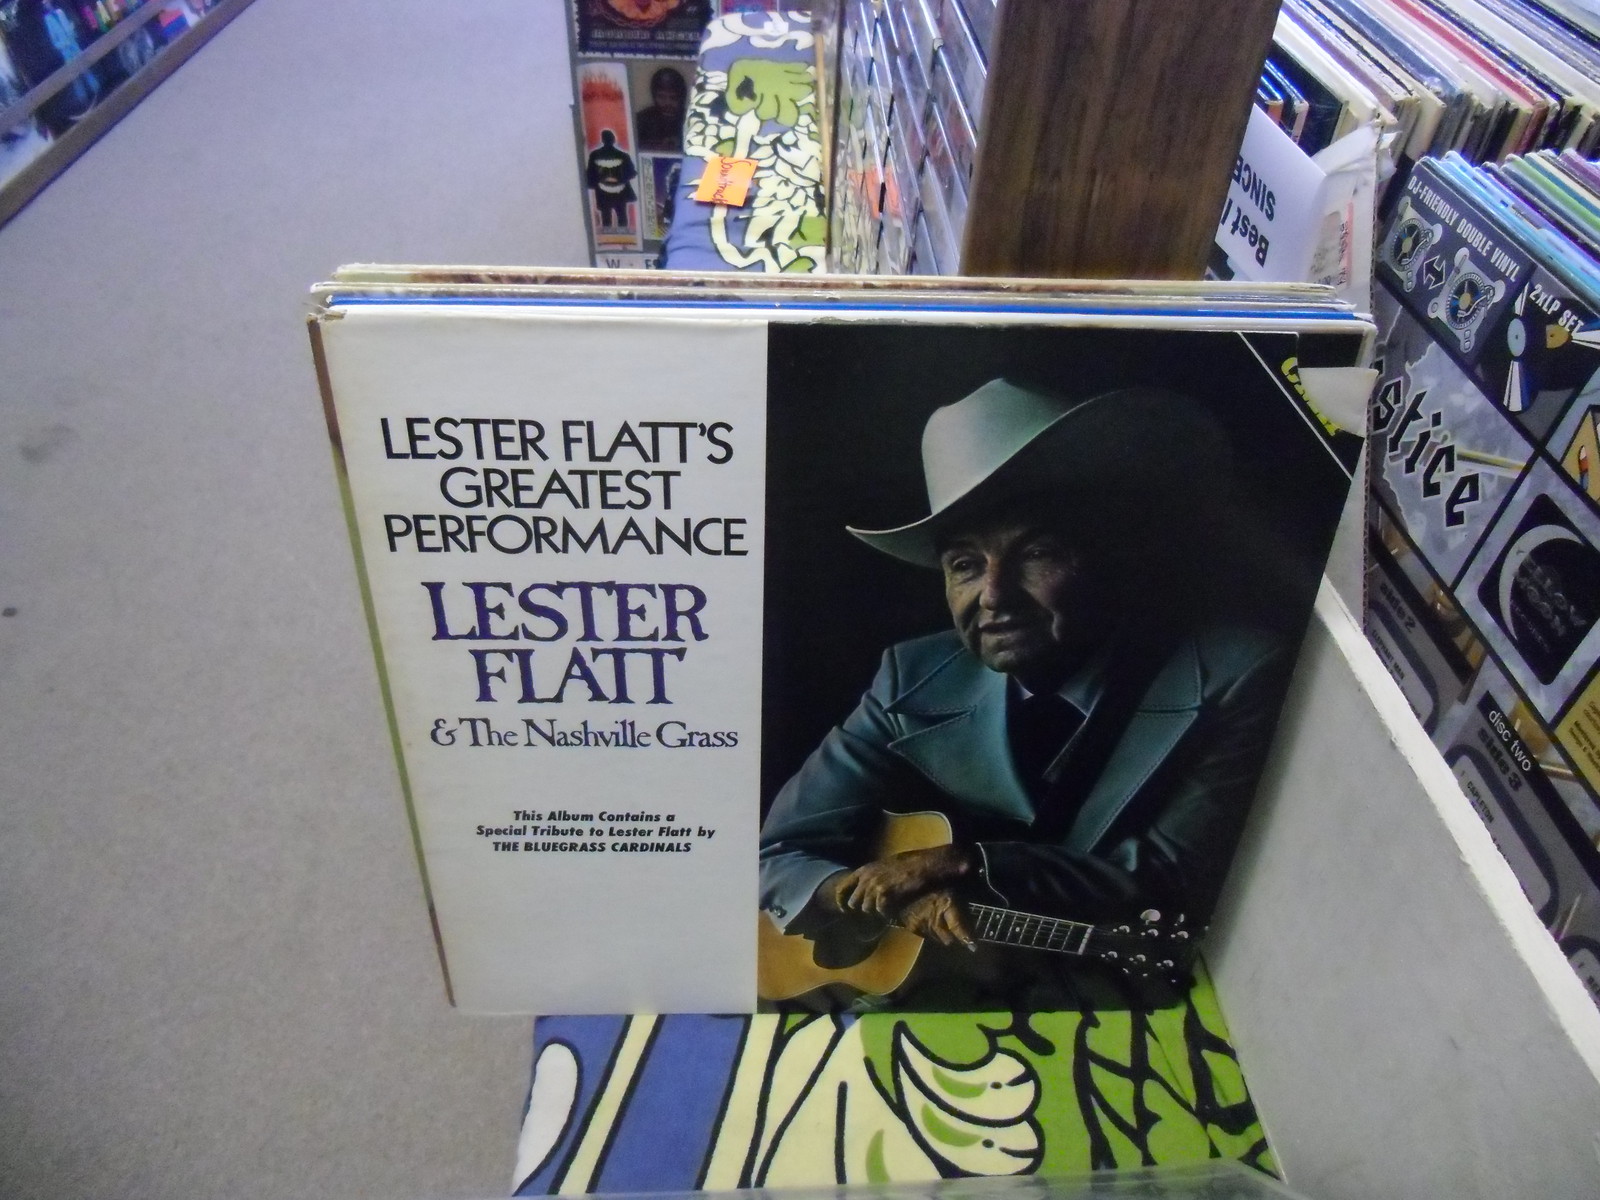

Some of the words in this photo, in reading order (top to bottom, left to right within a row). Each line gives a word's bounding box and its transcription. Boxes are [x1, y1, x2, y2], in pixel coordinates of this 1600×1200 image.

[1233, 156, 1277, 222] SINCE
[1229, 223, 1269, 267] Best
[1408, 175, 1458, 229] DJ-FRIENDLY
[1457, 218, 1492, 254] DOUBLE
[1490, 248, 1520, 283] VINYL
[1557, 304, 1585, 334] SET
[381, 417, 549, 461] LESTER
[563, 420, 734, 464] FLATT'S
[439, 467, 682, 510] GREATEST
[383, 514, 749, 556] PERFORMANCE
[421, 581, 709, 642] LESTER
[468, 647, 688, 705] FLATT
[430, 718, 456, 747] &
[459, 717, 519, 747] The
[522, 719, 652, 748] Nashville
[657, 721, 739, 748] Grass
[1488, 709, 1510, 742] disc
[1510, 740, 1531, 771] two
[513, 811, 543, 822] This
[547, 811, 594, 822] Album
[598, 811, 661, 822] Contains
[666, 814, 676, 822] a
[1466, 780, 1495, 824] CAPLETON
[476, 825, 527, 838] Special
[531, 825, 585, 837] Tribute
[589, 826, 604, 837] to
[608, 826, 654, 837] Lester
[658, 826, 692, 837] Flatt
[697, 826, 716, 839] by
[493, 841, 520, 852] THE
[524, 841, 608, 852] BLUEGRASS
[611, 841, 692, 852] CARDINALS
